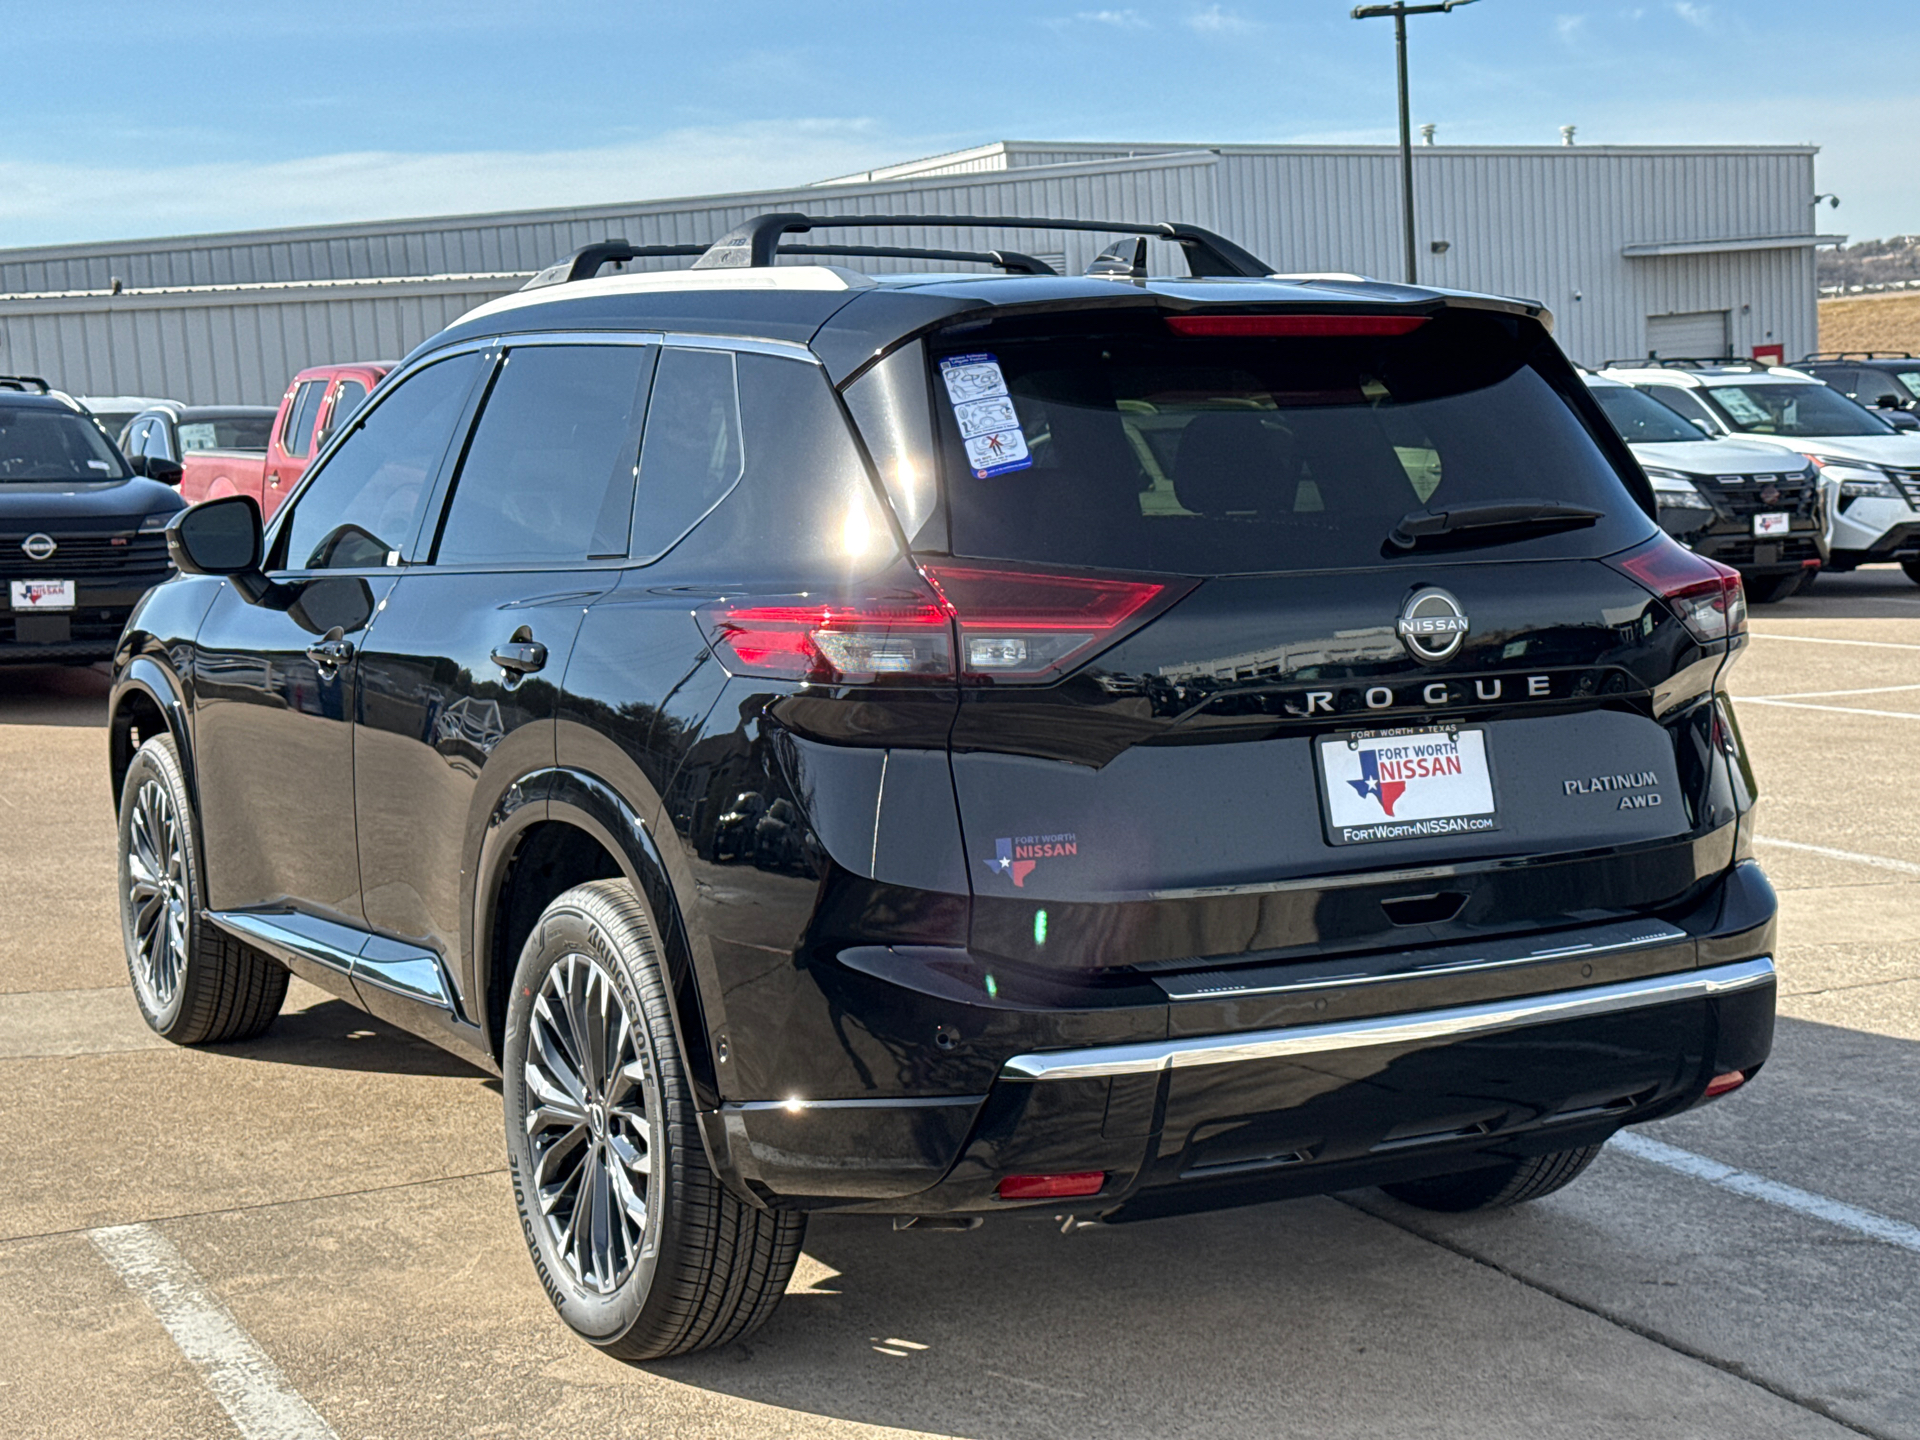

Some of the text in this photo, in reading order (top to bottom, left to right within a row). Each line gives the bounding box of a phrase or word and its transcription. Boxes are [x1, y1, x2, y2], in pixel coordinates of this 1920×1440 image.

[1401, 619, 1468, 632] NISSAN
[1307, 676, 1551, 713] ROGUE
[1351, 724, 1457, 739] FORT WORTH TEXAS
[1377, 743, 1459, 760] FORT WORTH
[1379, 755, 1462, 781] NISSAN
[1563, 771, 1659, 795] PLATINUM
[1618, 793, 1662, 809] AWD
[1015, 833, 1076, 845] FORT WORTH
[1015, 842, 1078, 859] NISSAN
[587, 923, 656, 1089] BRIDGESTONE
